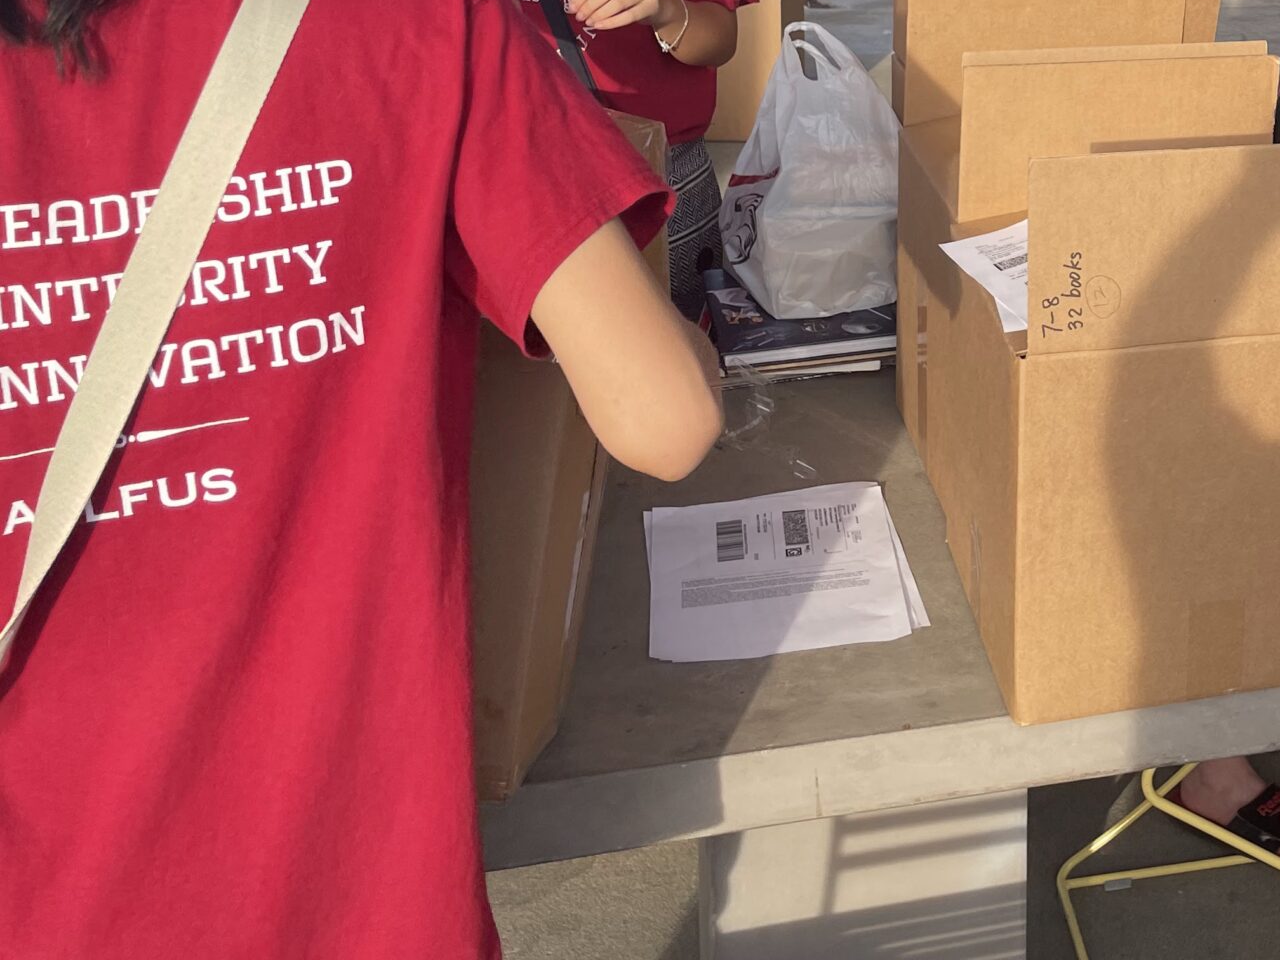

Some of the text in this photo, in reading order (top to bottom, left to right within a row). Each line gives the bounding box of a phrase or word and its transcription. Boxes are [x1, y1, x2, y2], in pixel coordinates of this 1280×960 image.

[1041, 296, 1063, 339] 7-8
[1060, 250, 1084, 331] 32 books
[3, 468, 238, 536] ALFUS
